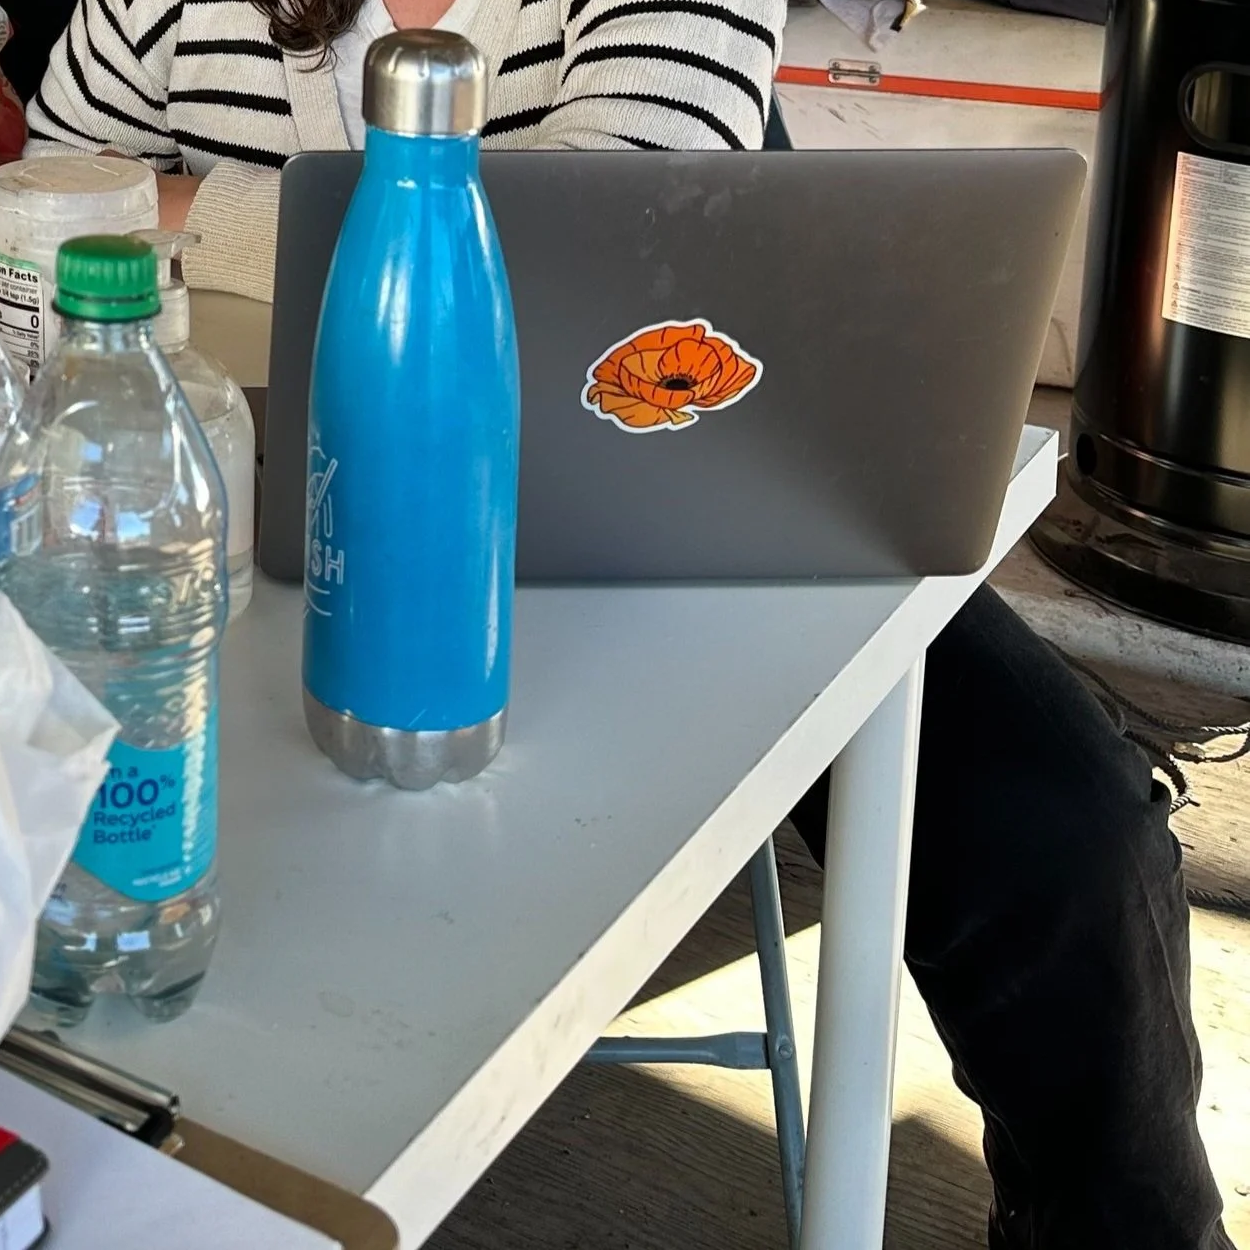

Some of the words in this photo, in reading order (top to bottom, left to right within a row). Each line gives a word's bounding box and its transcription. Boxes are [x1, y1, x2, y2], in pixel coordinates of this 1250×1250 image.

[9, 268, 39, 283] Facts
[30, 315, 39, 328] 0
[310, 538, 345, 585] SH
[93, 802, 176, 827] Recycled
